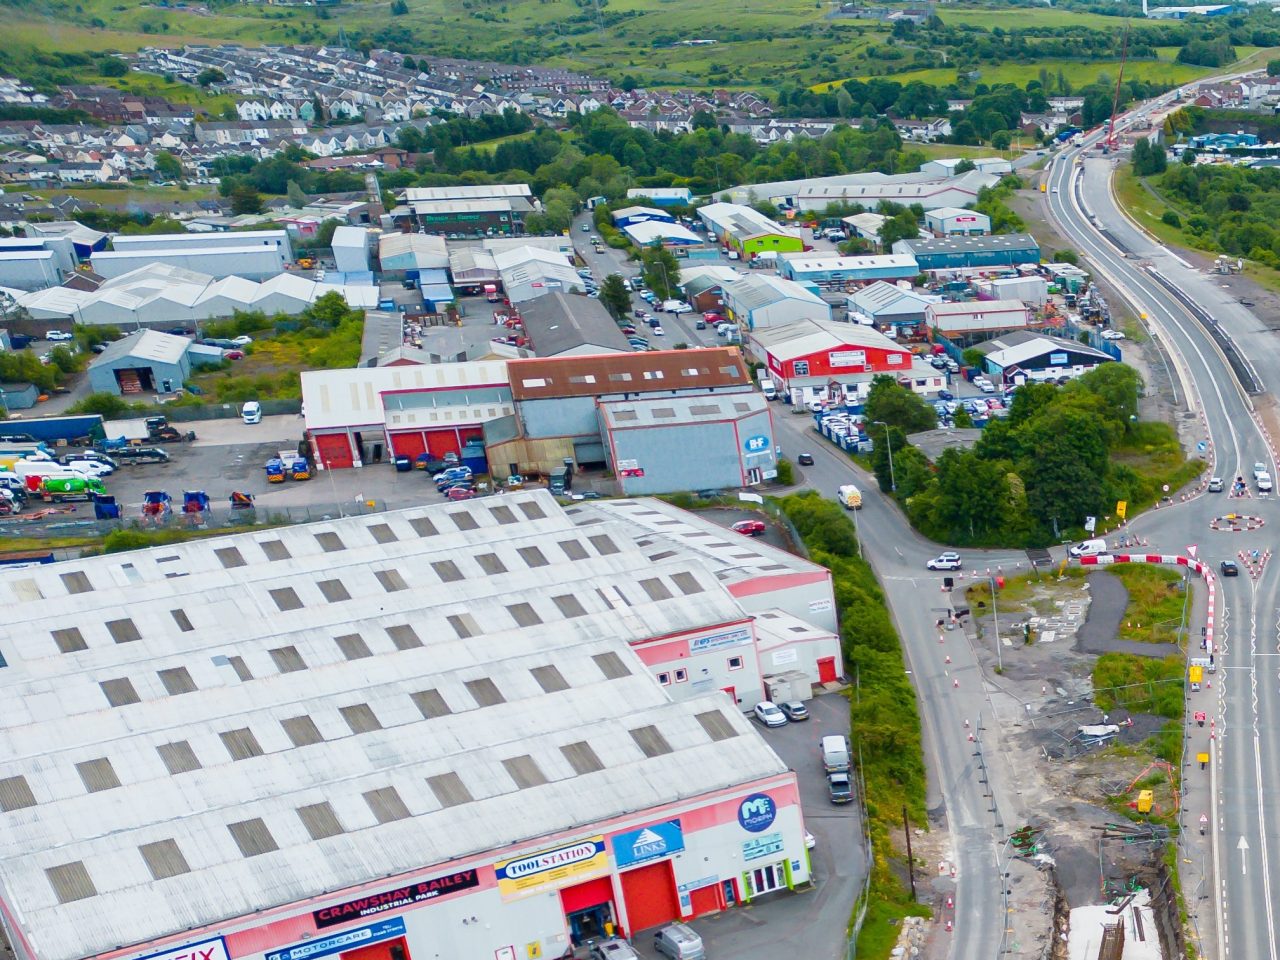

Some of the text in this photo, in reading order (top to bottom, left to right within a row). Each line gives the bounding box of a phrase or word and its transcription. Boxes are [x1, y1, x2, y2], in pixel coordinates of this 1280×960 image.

[510, 845, 594, 874] TOOLSTATION
[633, 841, 666, 857] LINKS
[318, 870, 473, 921] CRAWSHAY BAILEY
[360, 890, 439, 916] INDUSTRIAL PARK
[293, 930, 370, 956] MOTORCARE
